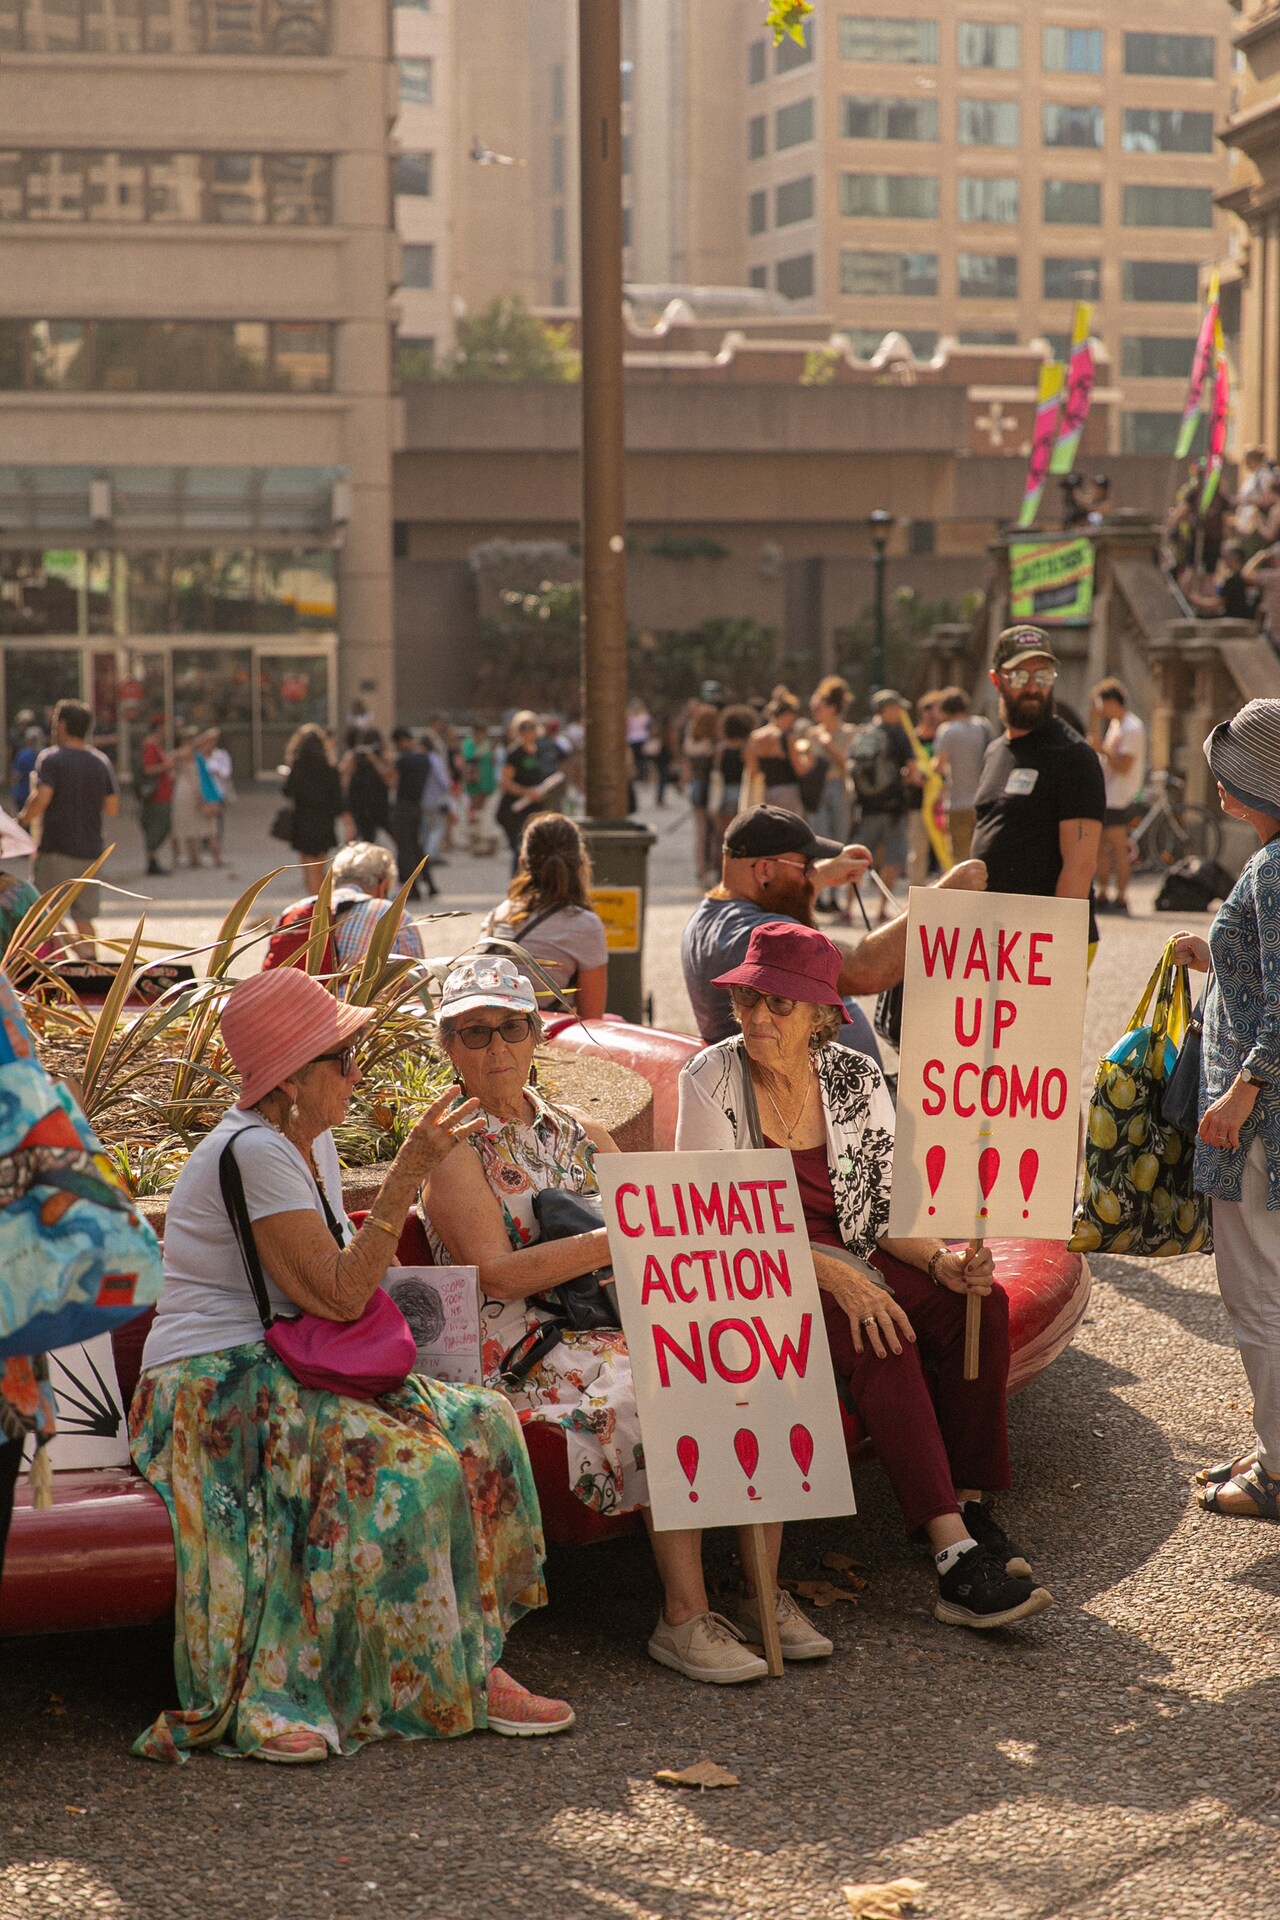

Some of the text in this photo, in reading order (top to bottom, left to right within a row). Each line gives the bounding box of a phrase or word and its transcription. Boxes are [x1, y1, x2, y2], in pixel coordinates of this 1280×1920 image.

[919, 925, 1054, 986] WAKE
[954, 996, 1017, 1050] UP
[921, 1058, 1068, 1121] SCOMO
[615, 1180, 795, 1238] CLIMATE
[641, 1248, 793, 1306] ACTION
[652, 1313, 813, 1388] NOW
